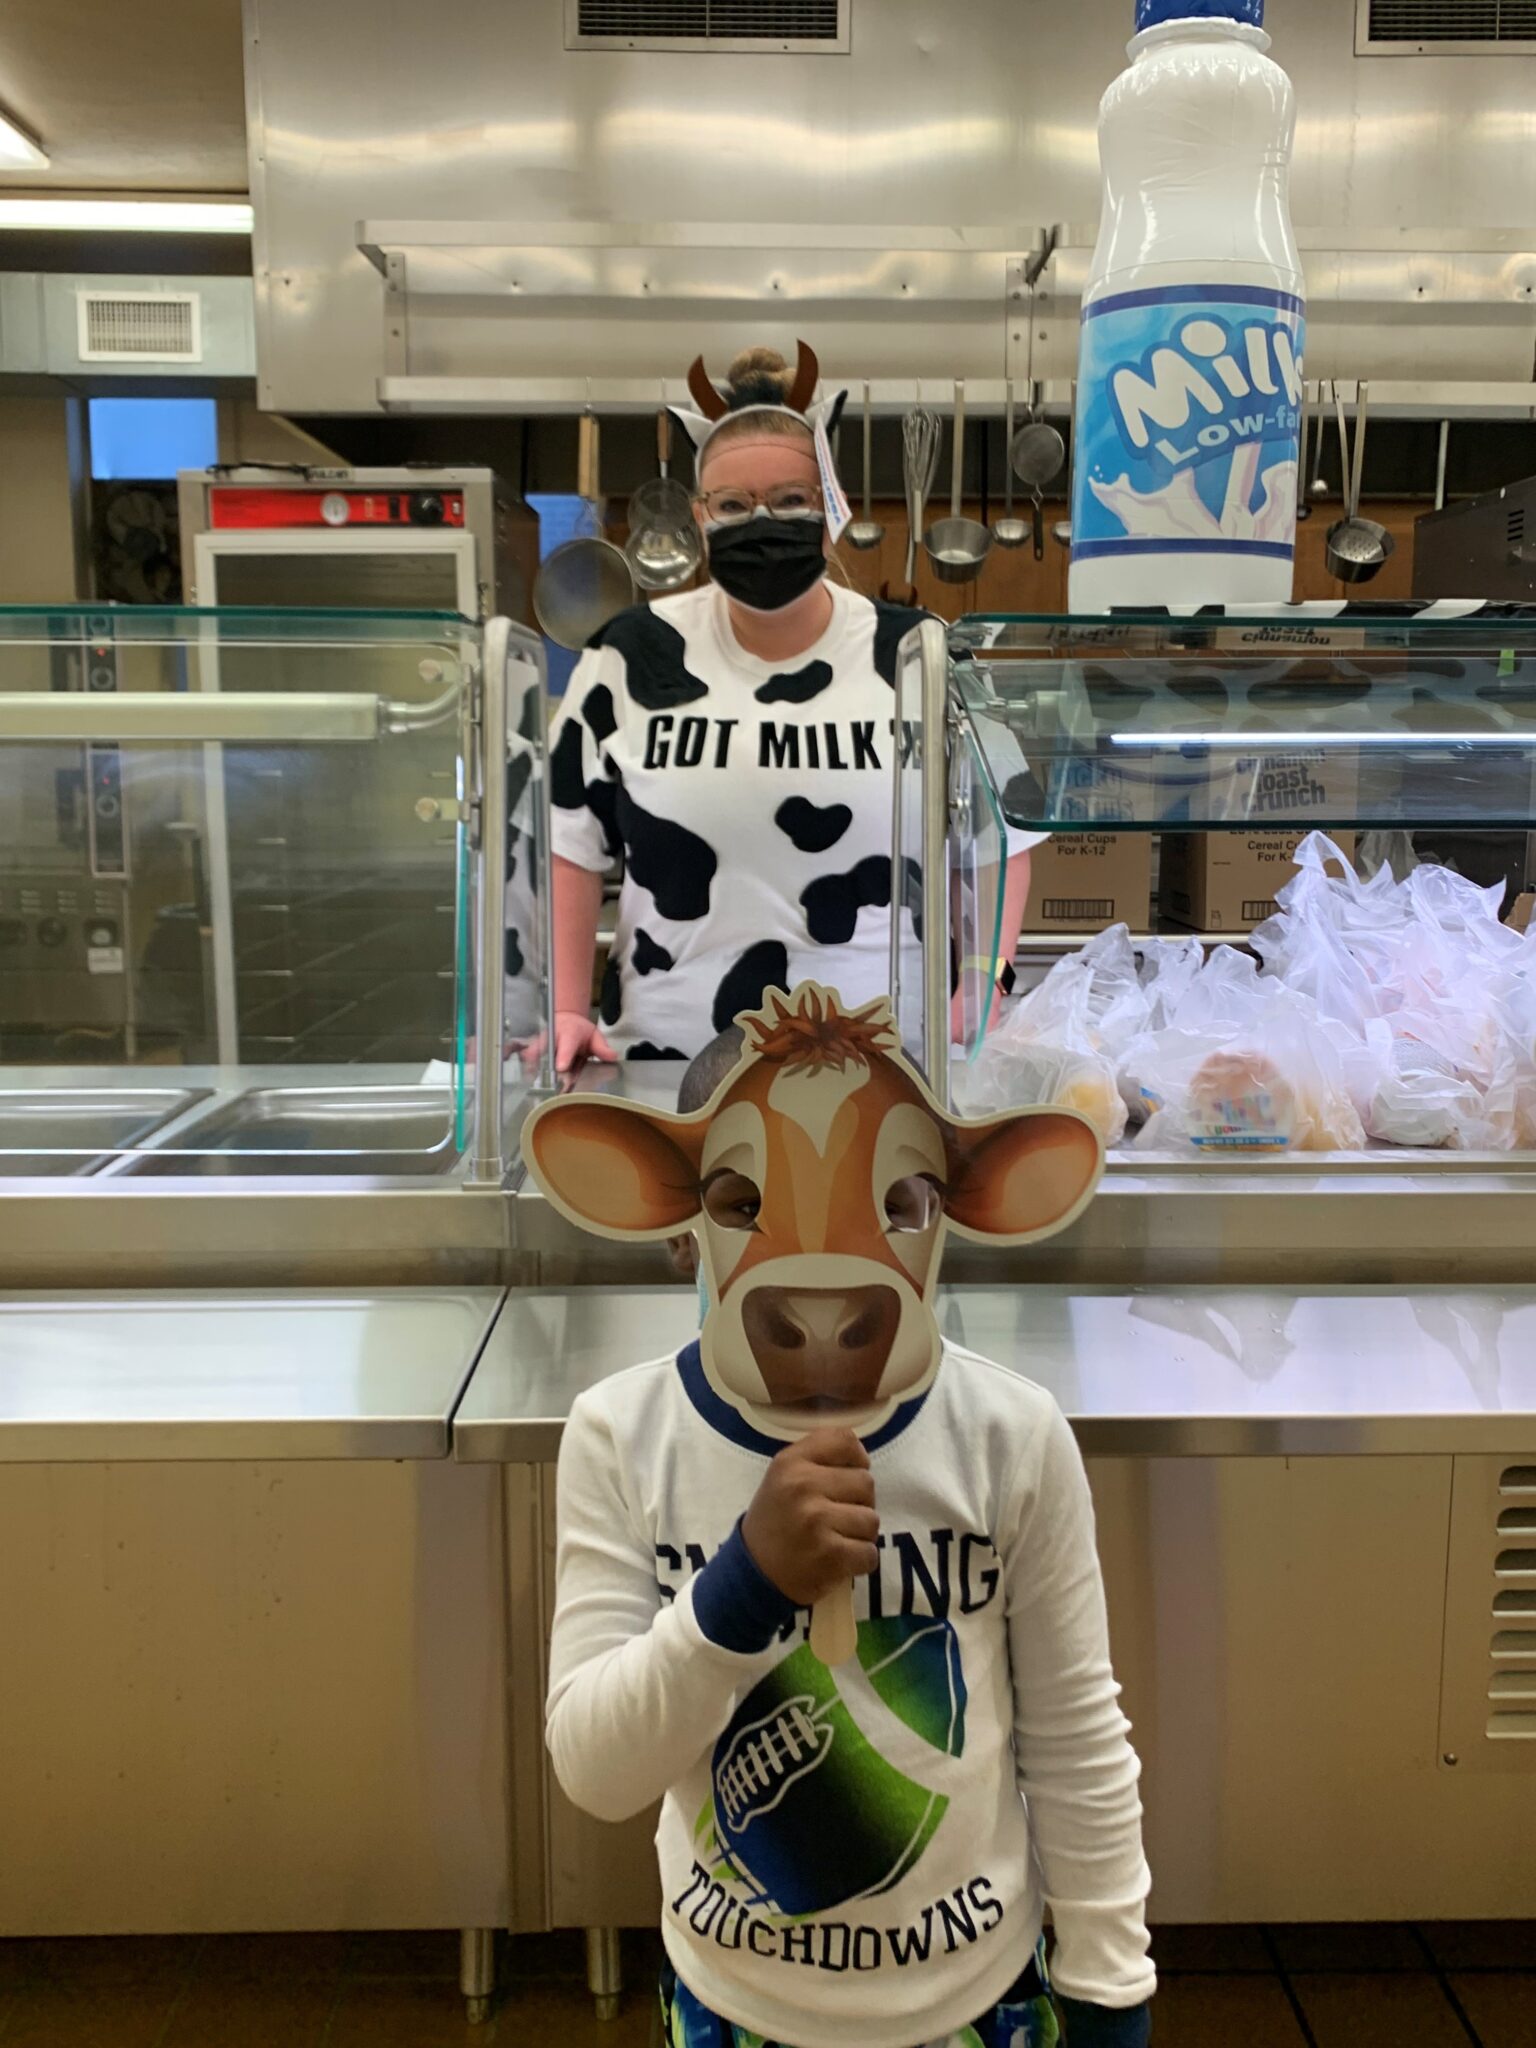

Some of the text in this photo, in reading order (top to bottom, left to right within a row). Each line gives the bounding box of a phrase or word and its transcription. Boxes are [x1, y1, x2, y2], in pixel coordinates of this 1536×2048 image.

[1113, 320, 1303, 448] Milk
[644, 714, 895, 770] GOT MILK
[1048, 833, 1117, 845] Cereal Cups
[1248, 840, 1283, 850] Cereal
[1057, 845, 1106, 856] For K-12
[1257, 852, 1276, 862] For
[672, 1860, 1004, 1971] TOUCHDOWNS
